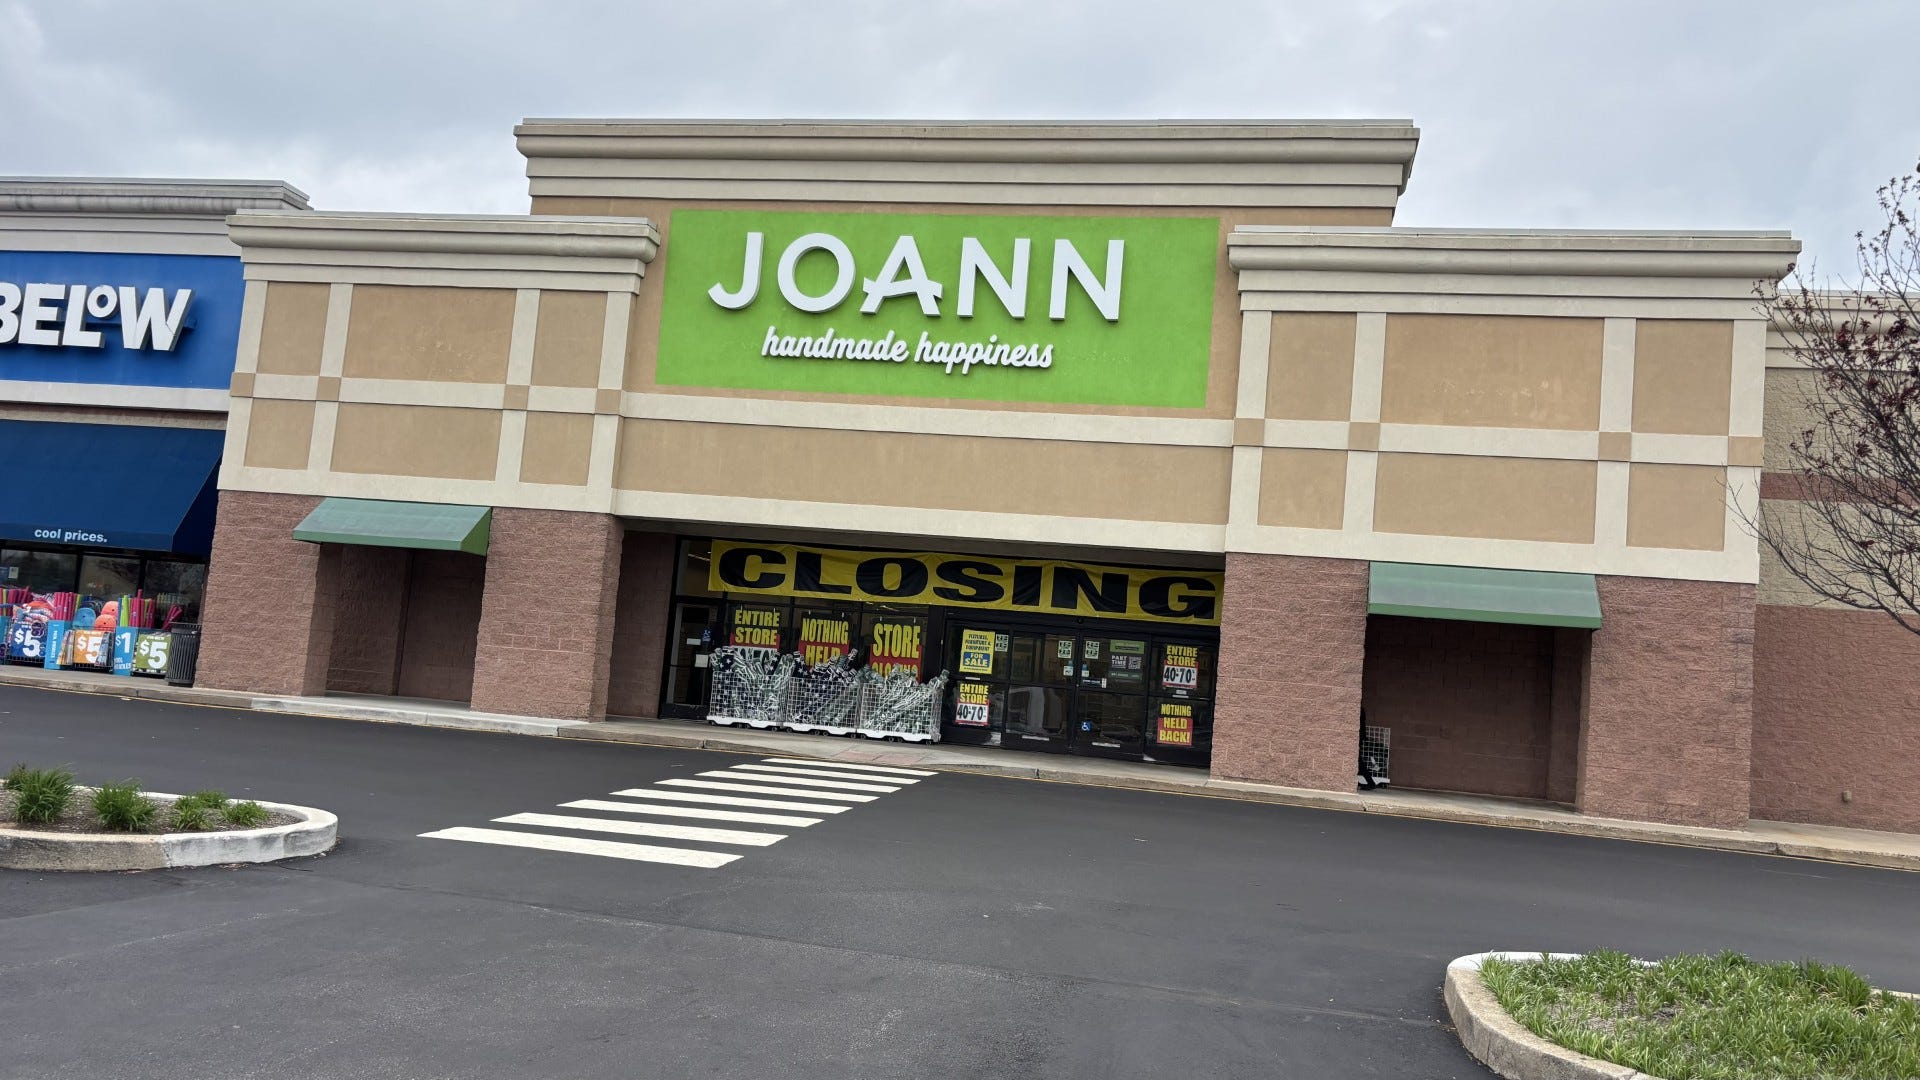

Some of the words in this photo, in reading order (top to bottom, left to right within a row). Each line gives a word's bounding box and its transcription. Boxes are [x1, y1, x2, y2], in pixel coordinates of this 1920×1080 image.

[708, 232, 1124, 321] JOANN
[761, 326, 908, 362] handmade
[914, 331, 1054, 374] happiness
[34, 529, 61, 539] cool
[64, 530, 108, 543] prices.
[719, 548, 1216, 619] CLOSING
[735, 609, 780, 627] ENTIRE
[735, 627, 777, 645] STORE
[801, 618, 849, 645] NOTHING
[873, 623, 921, 658] STORE
[14, 628, 42, 657] $5
[115, 632, 131, 654] $1
[1166, 645, 1198, 657] ENTIRE
[140, 639, 168, 669] $5
[964, 658, 989, 667] SALE
[1167, 655, 1196, 667] STORE
[960, 683, 989, 695] ENTIRE
[960, 693, 987, 705] STORE
[1161, 704, 1192, 717] NOTHING
[1163, 717, 1188, 729] HELD
[1160, 730, 1191, 743] BACK!
